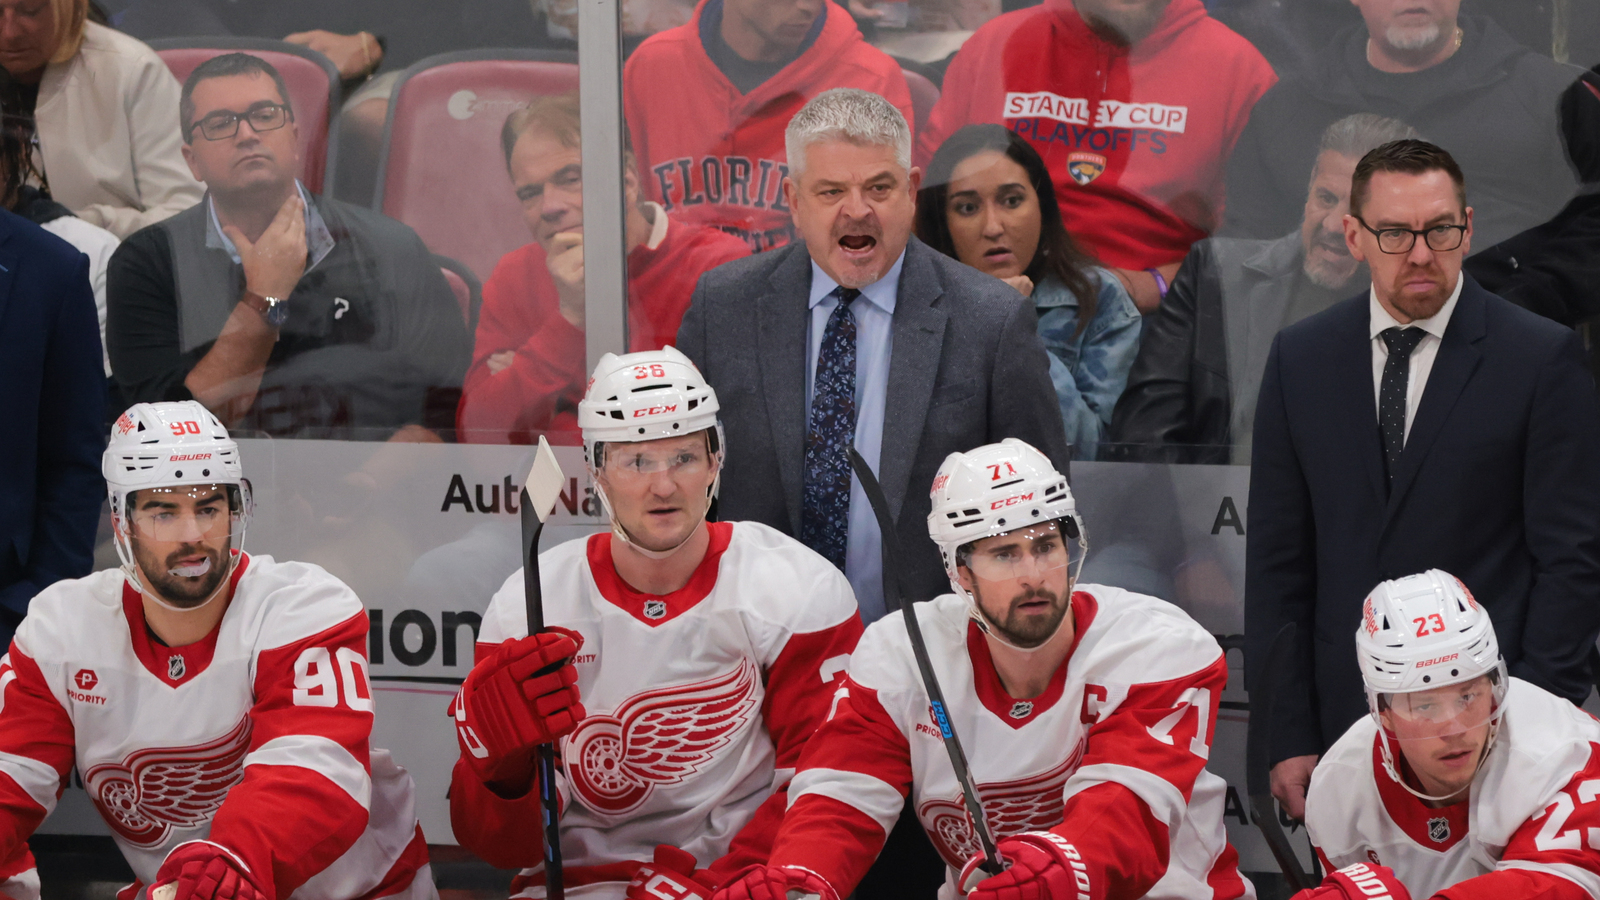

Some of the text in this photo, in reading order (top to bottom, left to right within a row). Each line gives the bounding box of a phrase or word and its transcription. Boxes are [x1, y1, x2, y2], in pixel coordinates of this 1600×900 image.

[1009, 95, 1184, 128] STANLEY CUP
[1013, 118, 1167, 154] PLAYOFFS
[633, 364, 666, 380] 36
[633, 405, 677, 418] CCM
[169, 421, 201, 436] 90
[169, 453, 212, 462] BAUER
[986, 462, 1017, 481] 71
[990, 492, 1035, 511] CCM
[1412, 613, 1446, 638] 23
[1415, 653, 1459, 668] BAUER
[293, 647, 375, 712] 90
[1080, 683, 1108, 725] C
[933, 704, 951, 736] CCM
[1146, 687, 1211, 761] 71
